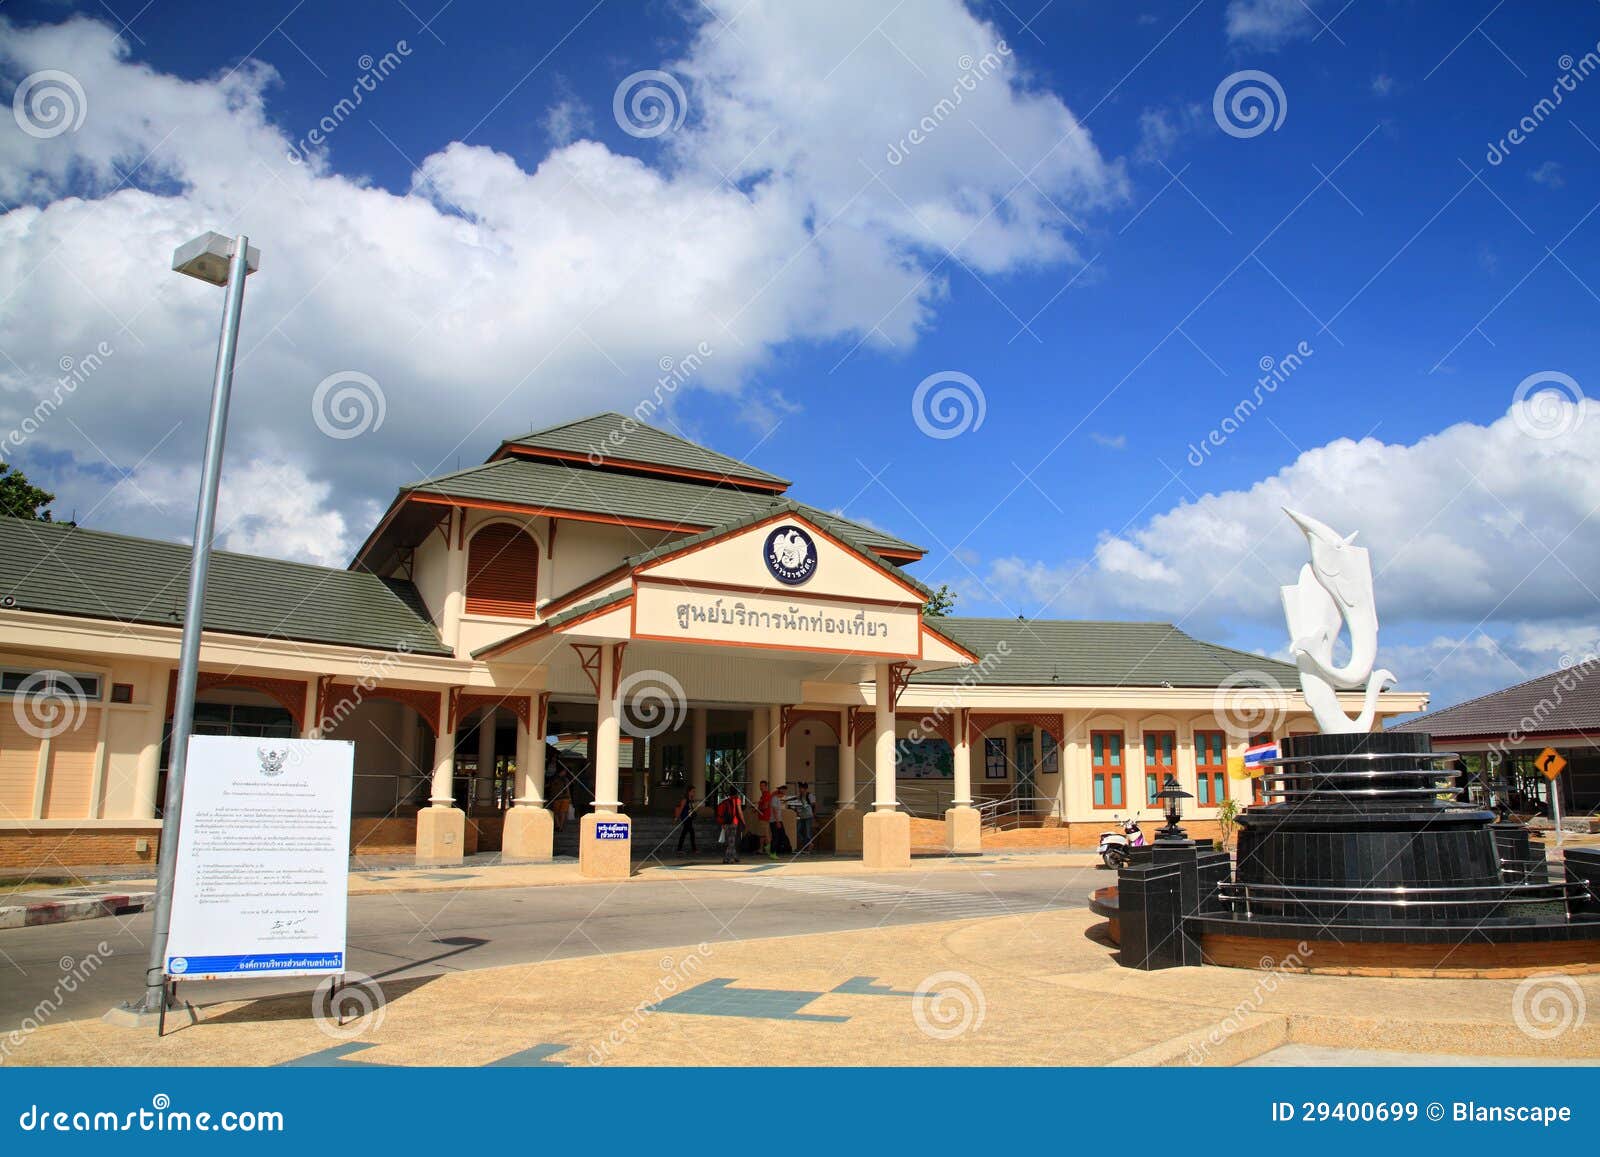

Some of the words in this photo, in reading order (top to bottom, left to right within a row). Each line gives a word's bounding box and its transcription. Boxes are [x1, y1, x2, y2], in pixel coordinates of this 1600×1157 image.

[677, 598, 888, 637] ศูนย์บริการนักท่องเที่ยว
[239, 954, 341, 969] องค์การบริหารส่วนตำบลปากน้ำ
